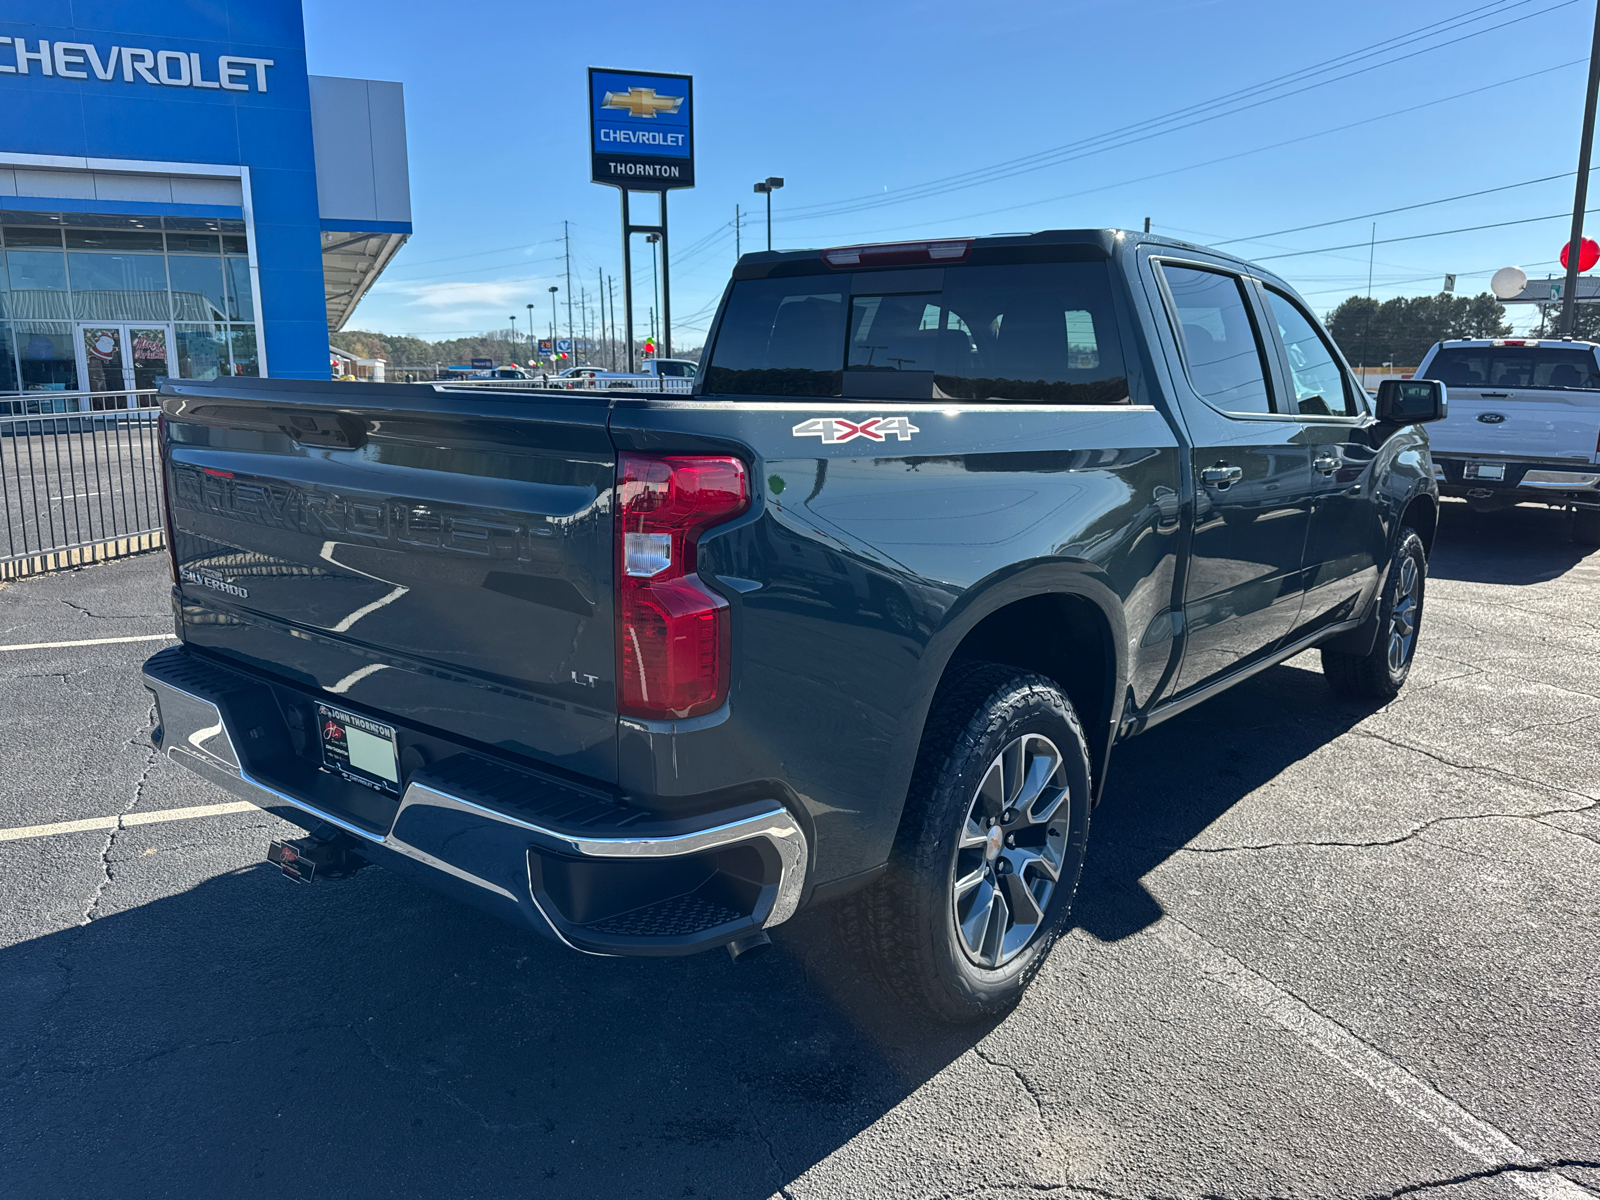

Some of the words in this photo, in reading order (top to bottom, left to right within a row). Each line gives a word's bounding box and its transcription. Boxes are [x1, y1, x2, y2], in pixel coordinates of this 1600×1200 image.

[600, 128, 685, 146] CHEVROLET
[608, 162, 679, 178] THORNTON
[174, 468, 557, 562] CHEVROLET
[181, 569, 249, 599] SILVERADO
[571, 670, 600, 689] LT
[331, 709, 350, 723] JOHN
[351, 716, 391, 738] THORNTON
